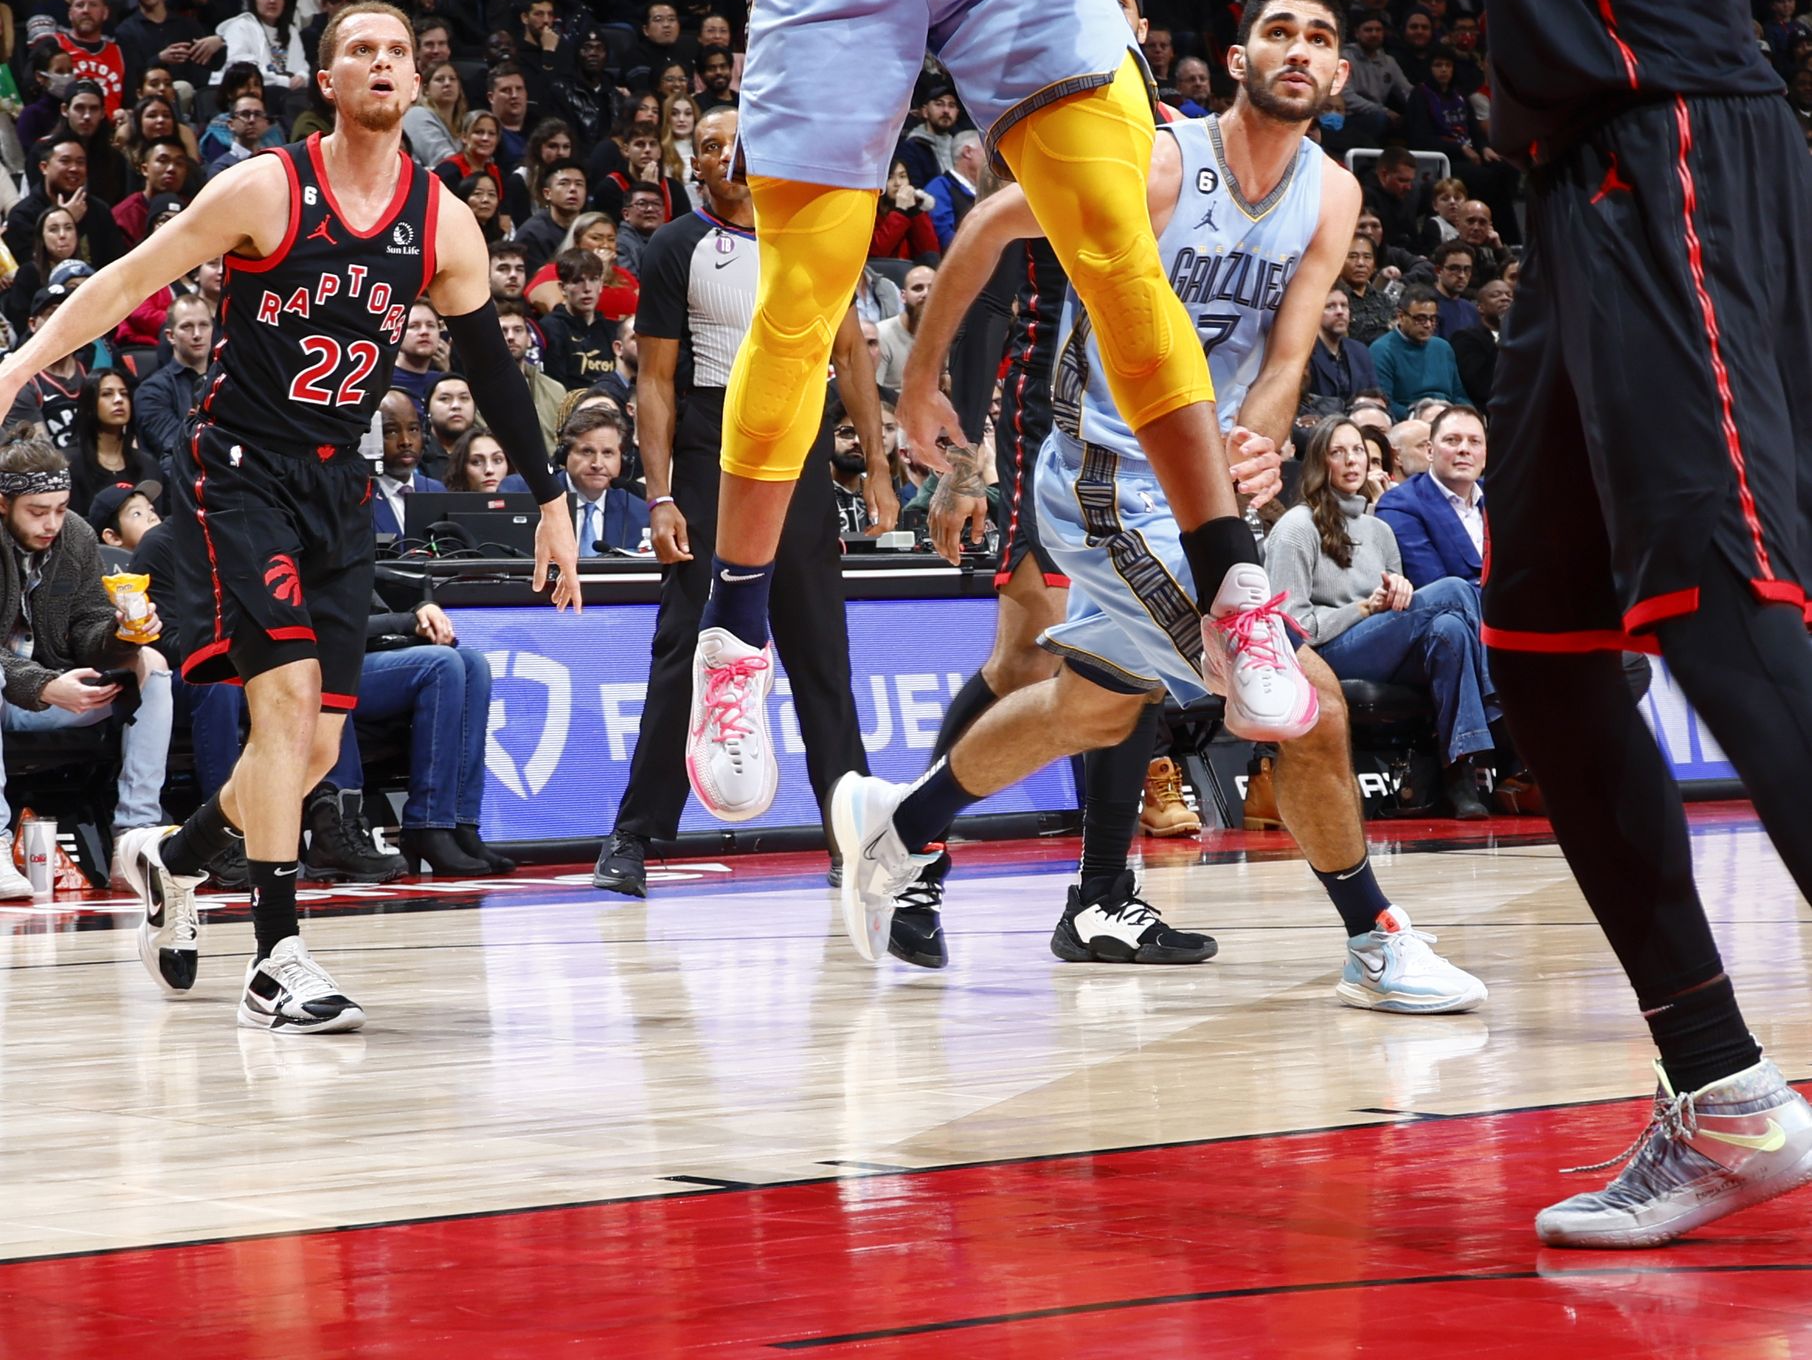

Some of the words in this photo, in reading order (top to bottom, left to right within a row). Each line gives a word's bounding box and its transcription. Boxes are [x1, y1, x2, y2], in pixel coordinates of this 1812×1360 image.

[304, 185, 318, 206] 6
[1199, 171, 1214, 192] 6
[386, 245, 402, 255] Sun
[403, 246, 420, 255] Life
[257, 264, 406, 345] RAPTORS
[1198, 314, 1241, 359] 7
[288, 334, 380, 407] 22
